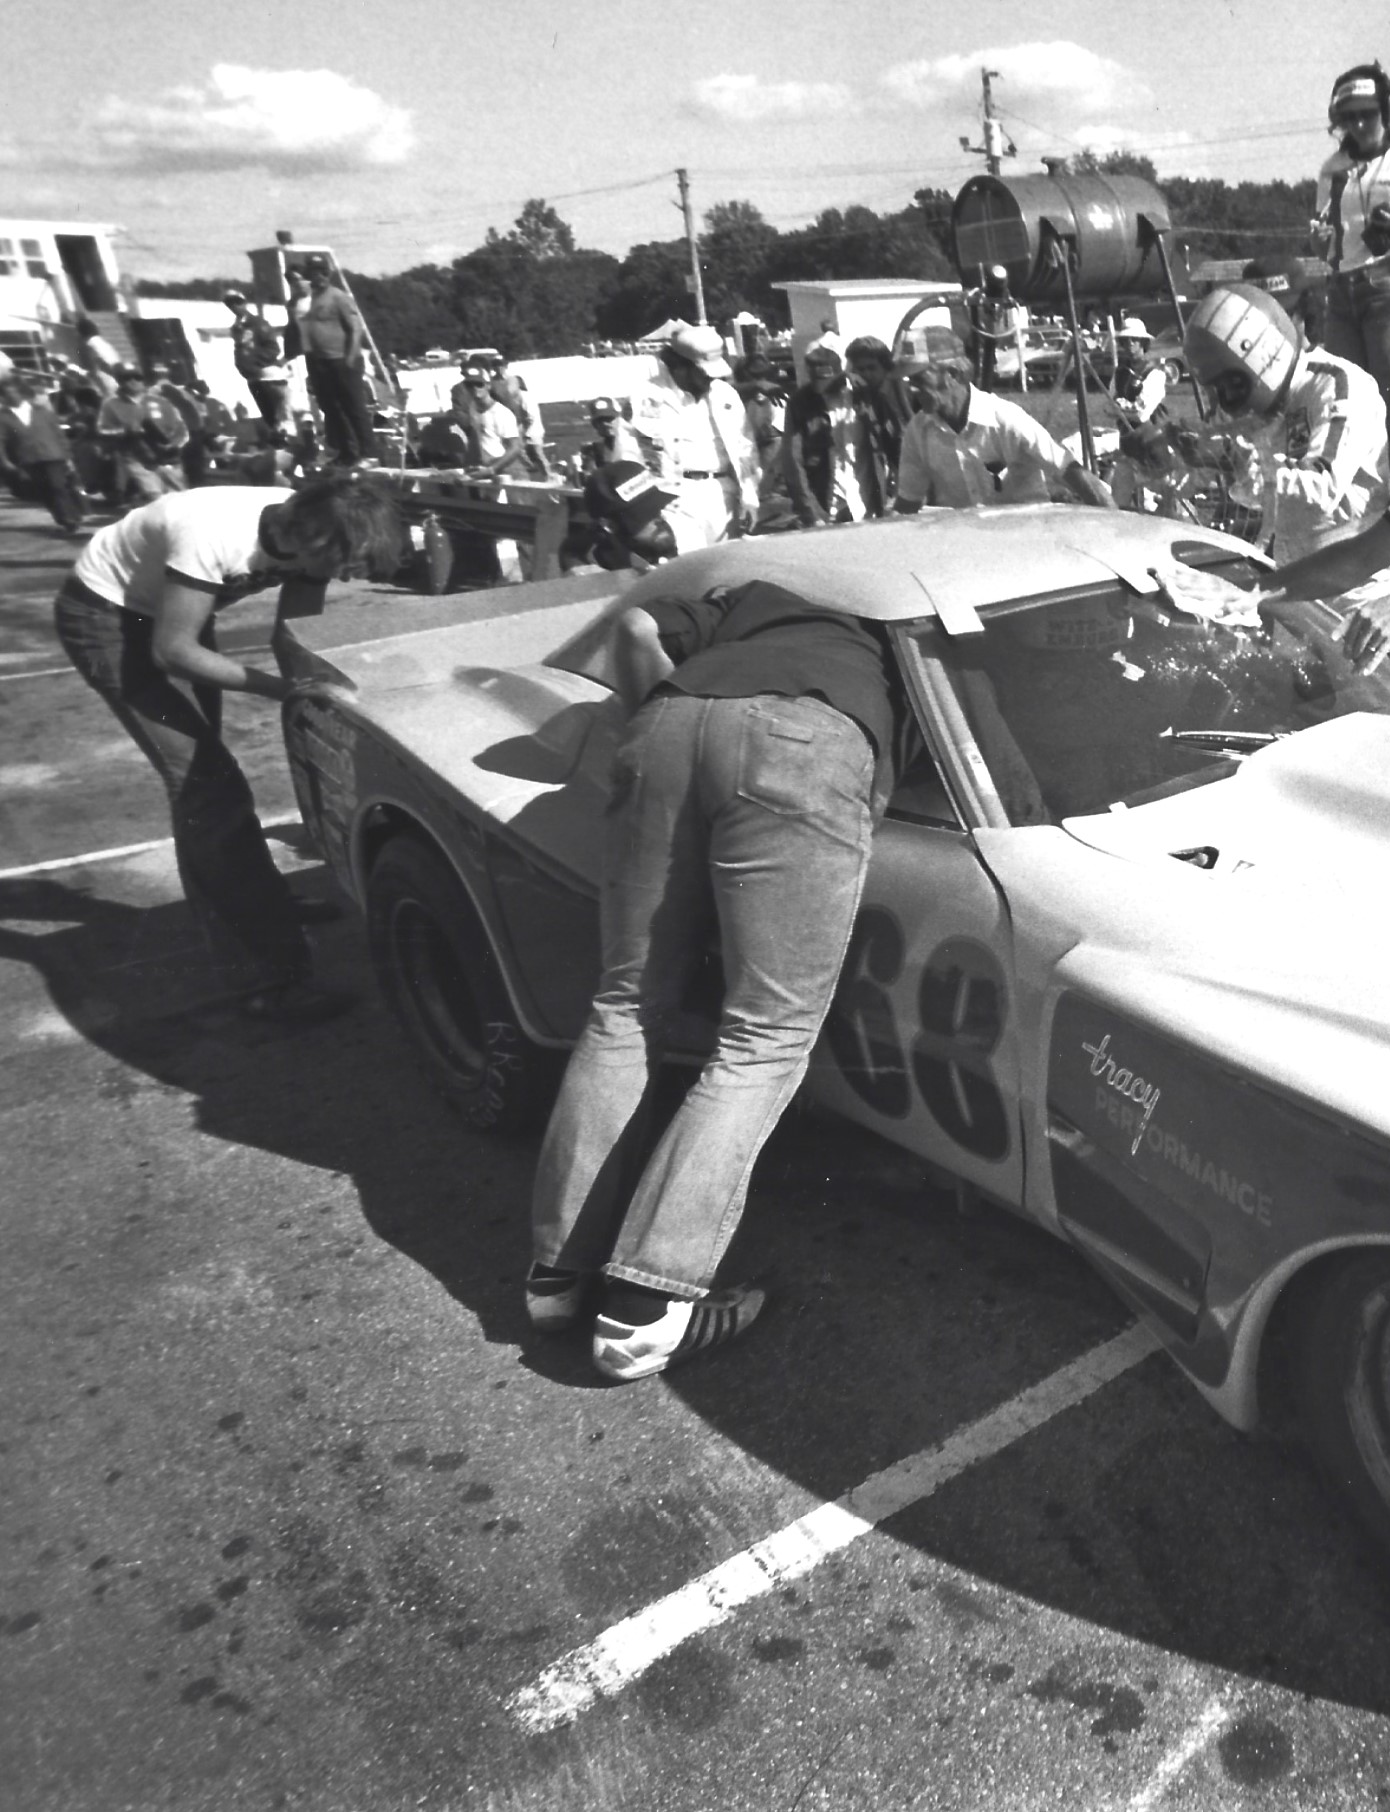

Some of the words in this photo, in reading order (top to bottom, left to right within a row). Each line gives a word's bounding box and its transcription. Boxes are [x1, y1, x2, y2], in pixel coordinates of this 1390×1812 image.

[825, 903, 1012, 1164] 68
[1081, 1034, 1161, 1156] tracy
[1095, 1087, 1273, 1227] PERORMANCE
